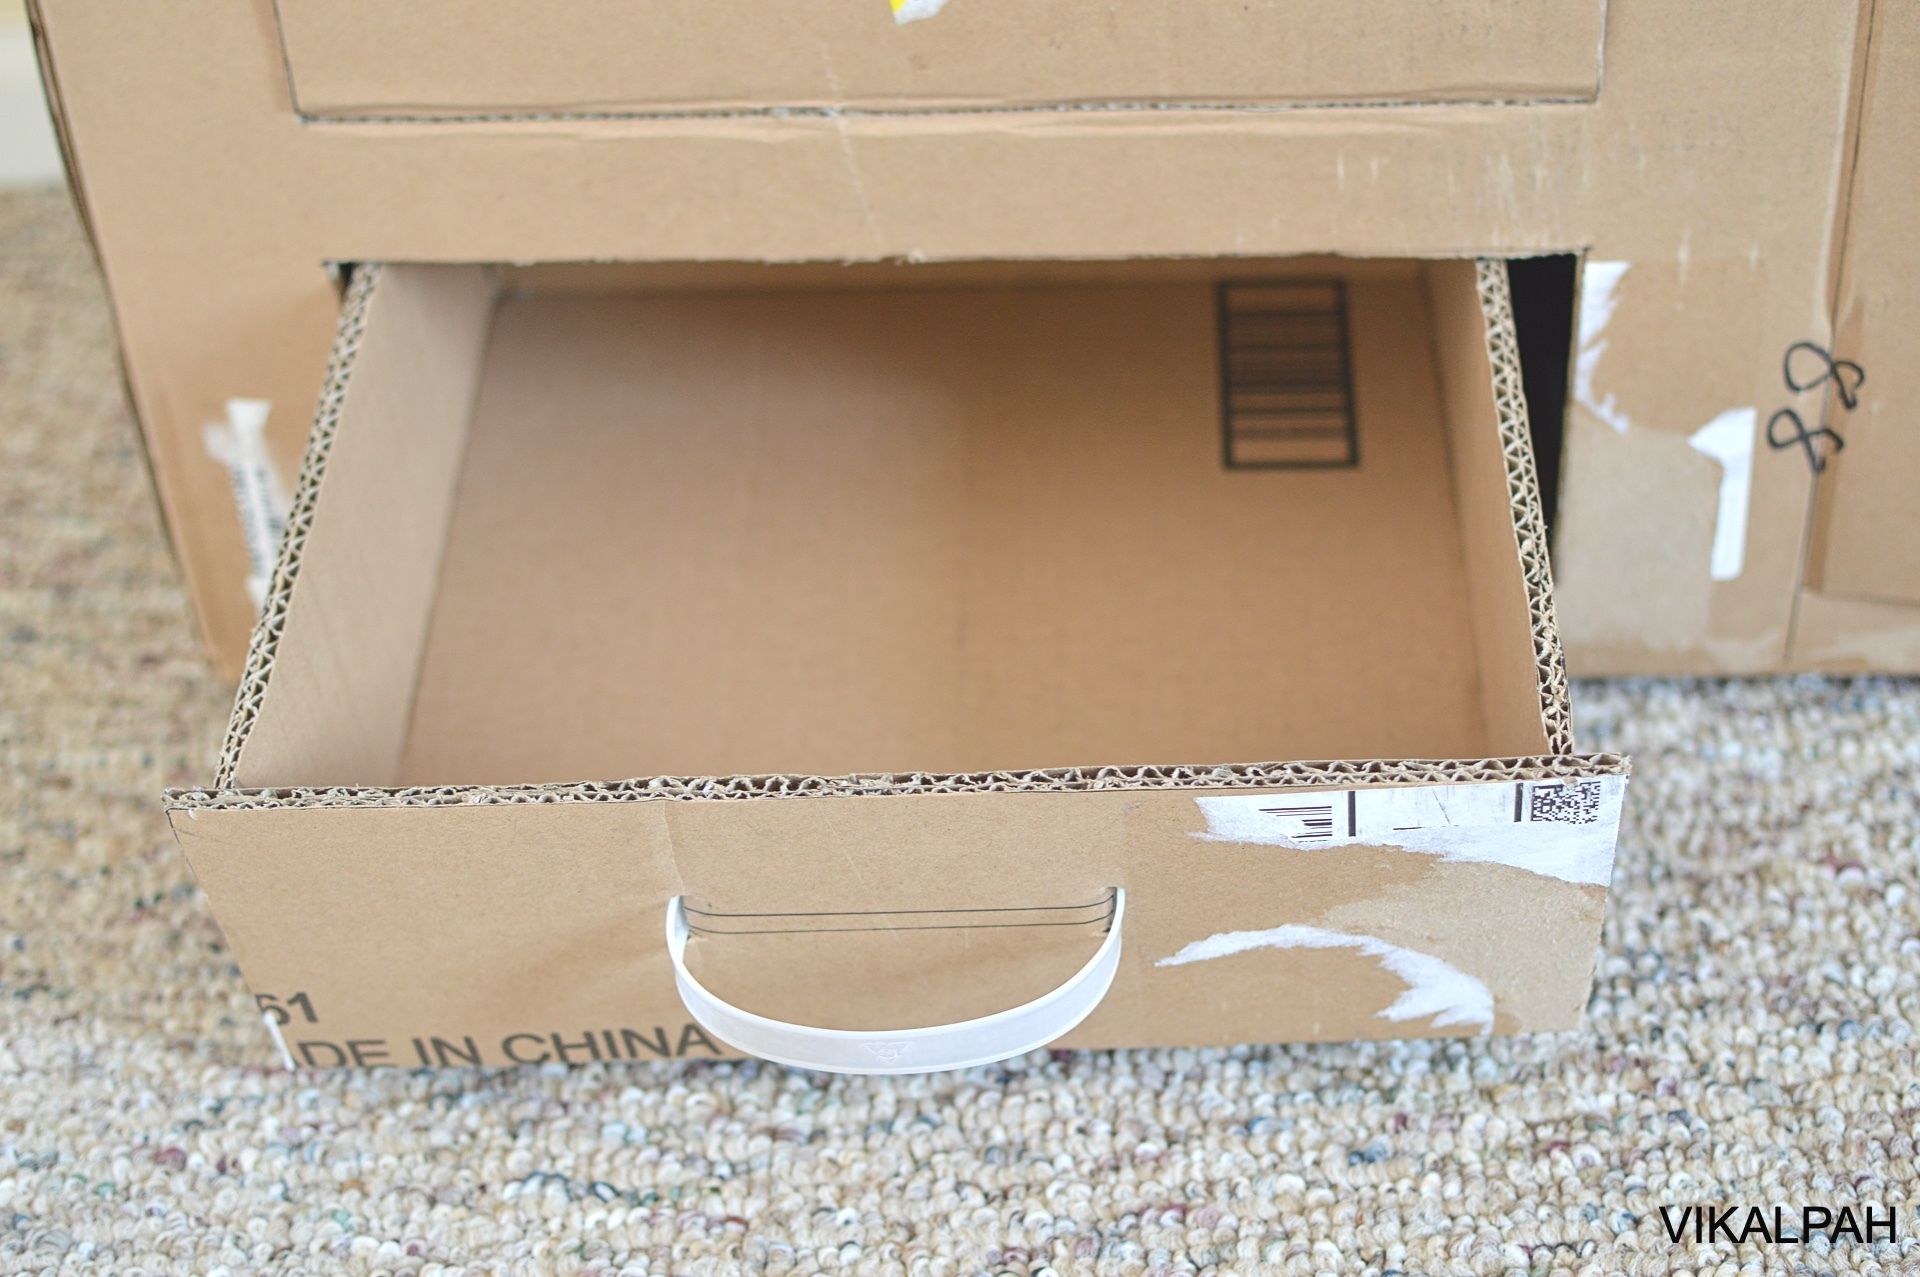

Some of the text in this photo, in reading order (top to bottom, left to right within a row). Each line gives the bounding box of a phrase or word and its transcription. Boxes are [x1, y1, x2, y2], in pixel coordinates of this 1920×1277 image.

[294, 1021, 723, 1068] DE IN CHINA
